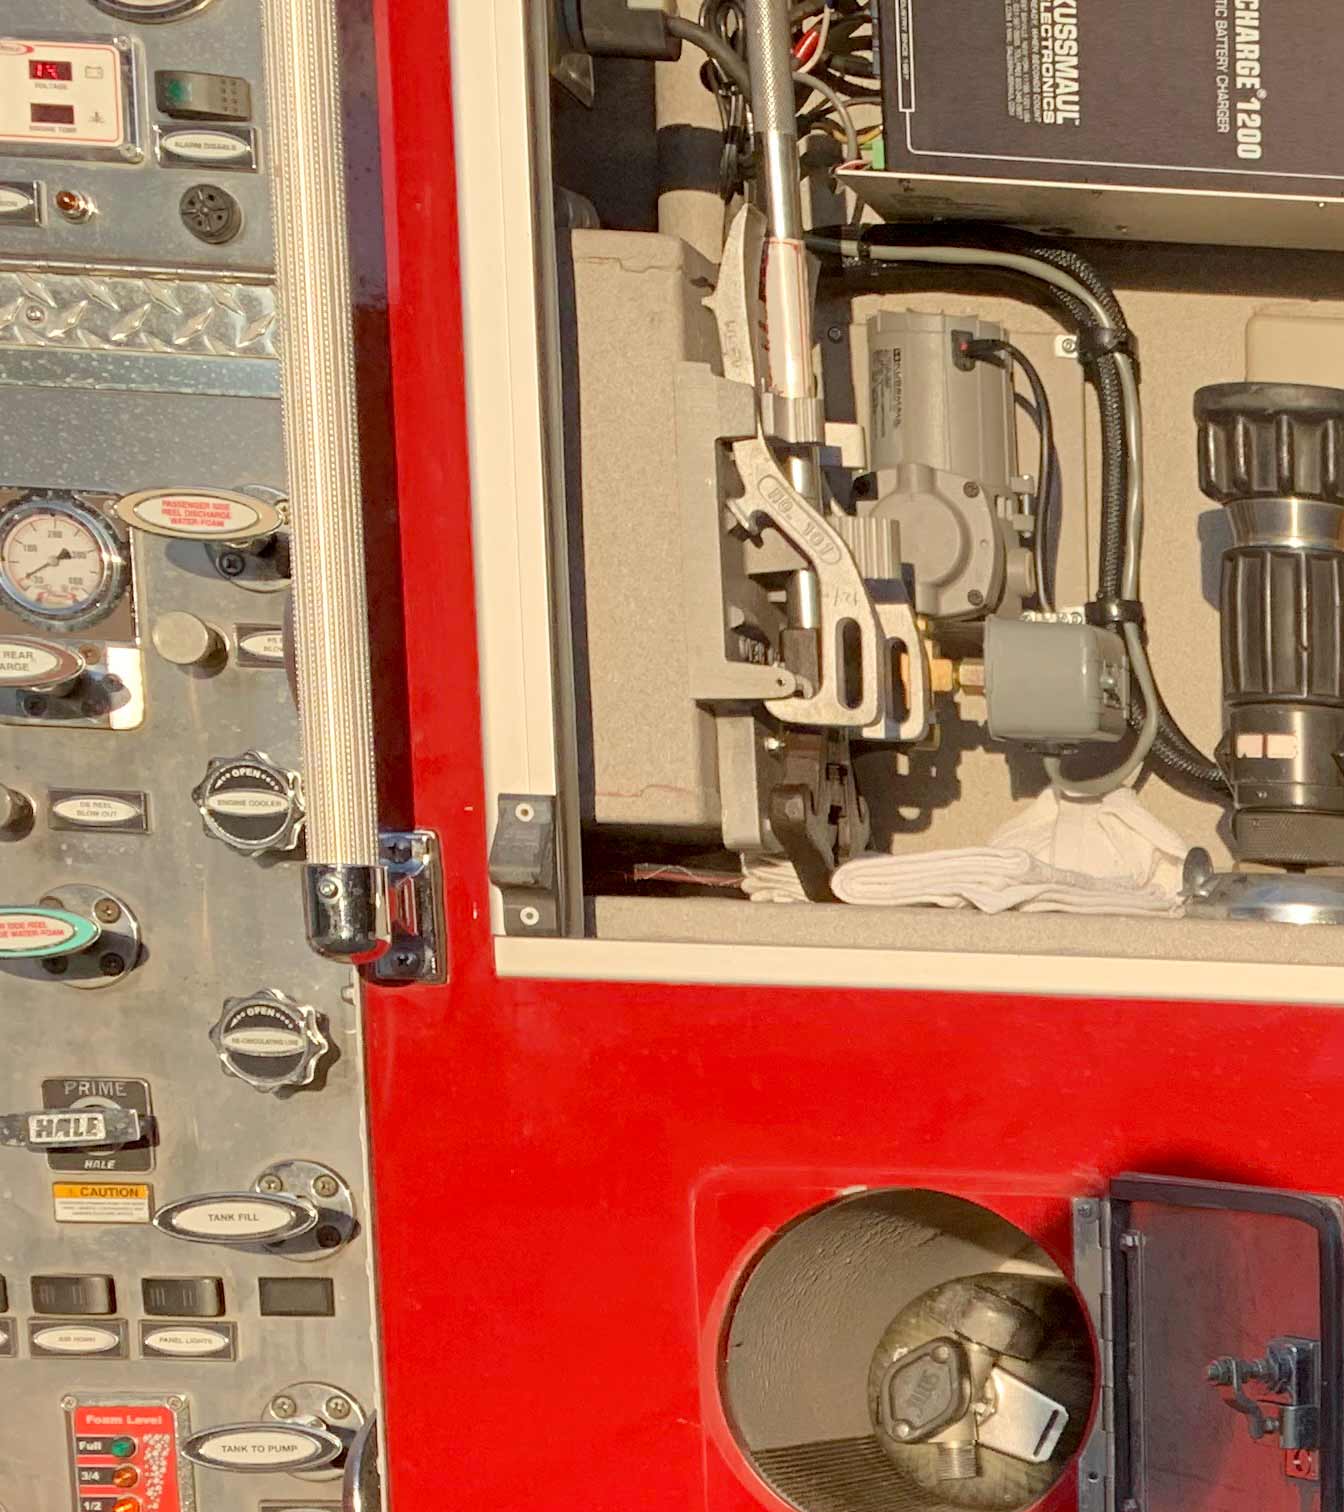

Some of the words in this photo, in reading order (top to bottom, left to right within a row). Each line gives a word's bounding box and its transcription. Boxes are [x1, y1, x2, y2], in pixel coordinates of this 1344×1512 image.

[1216, 20, 1229, 72] BATTERY
[1040, 0, 1055, 124] LECTRONICS
[1216, 76, 1230, 133] CHARGER
[1237, 97, 1262, 159] 1200
[3, 651, 33, 660] REAR
[231, 768, 261, 780] OPEN
[246, 1007, 276, 1018] OPEN
[64, 1080, 128, 1097] PRIME
[34, 1116, 101, 1140] HALE
[84, 1159, 117, 1170] HALE
[80, 1186, 140, 1198] CAUTION
[208, 1213, 235, 1223] TANK
[238, 1213, 260, 1222] FILL
[86, 1414, 123, 1425] Foam
[126, 1415, 163, 1426] Level
[79, 1440, 102, 1452] Full
[222, 1444, 249, 1454] TANK
[251, 1444, 265, 1454] TO
[268, 1444, 298, 1454] PUMP
[81, 1471, 100, 1482] 3/4
[83, 1501, 102, 1512] 1/2
